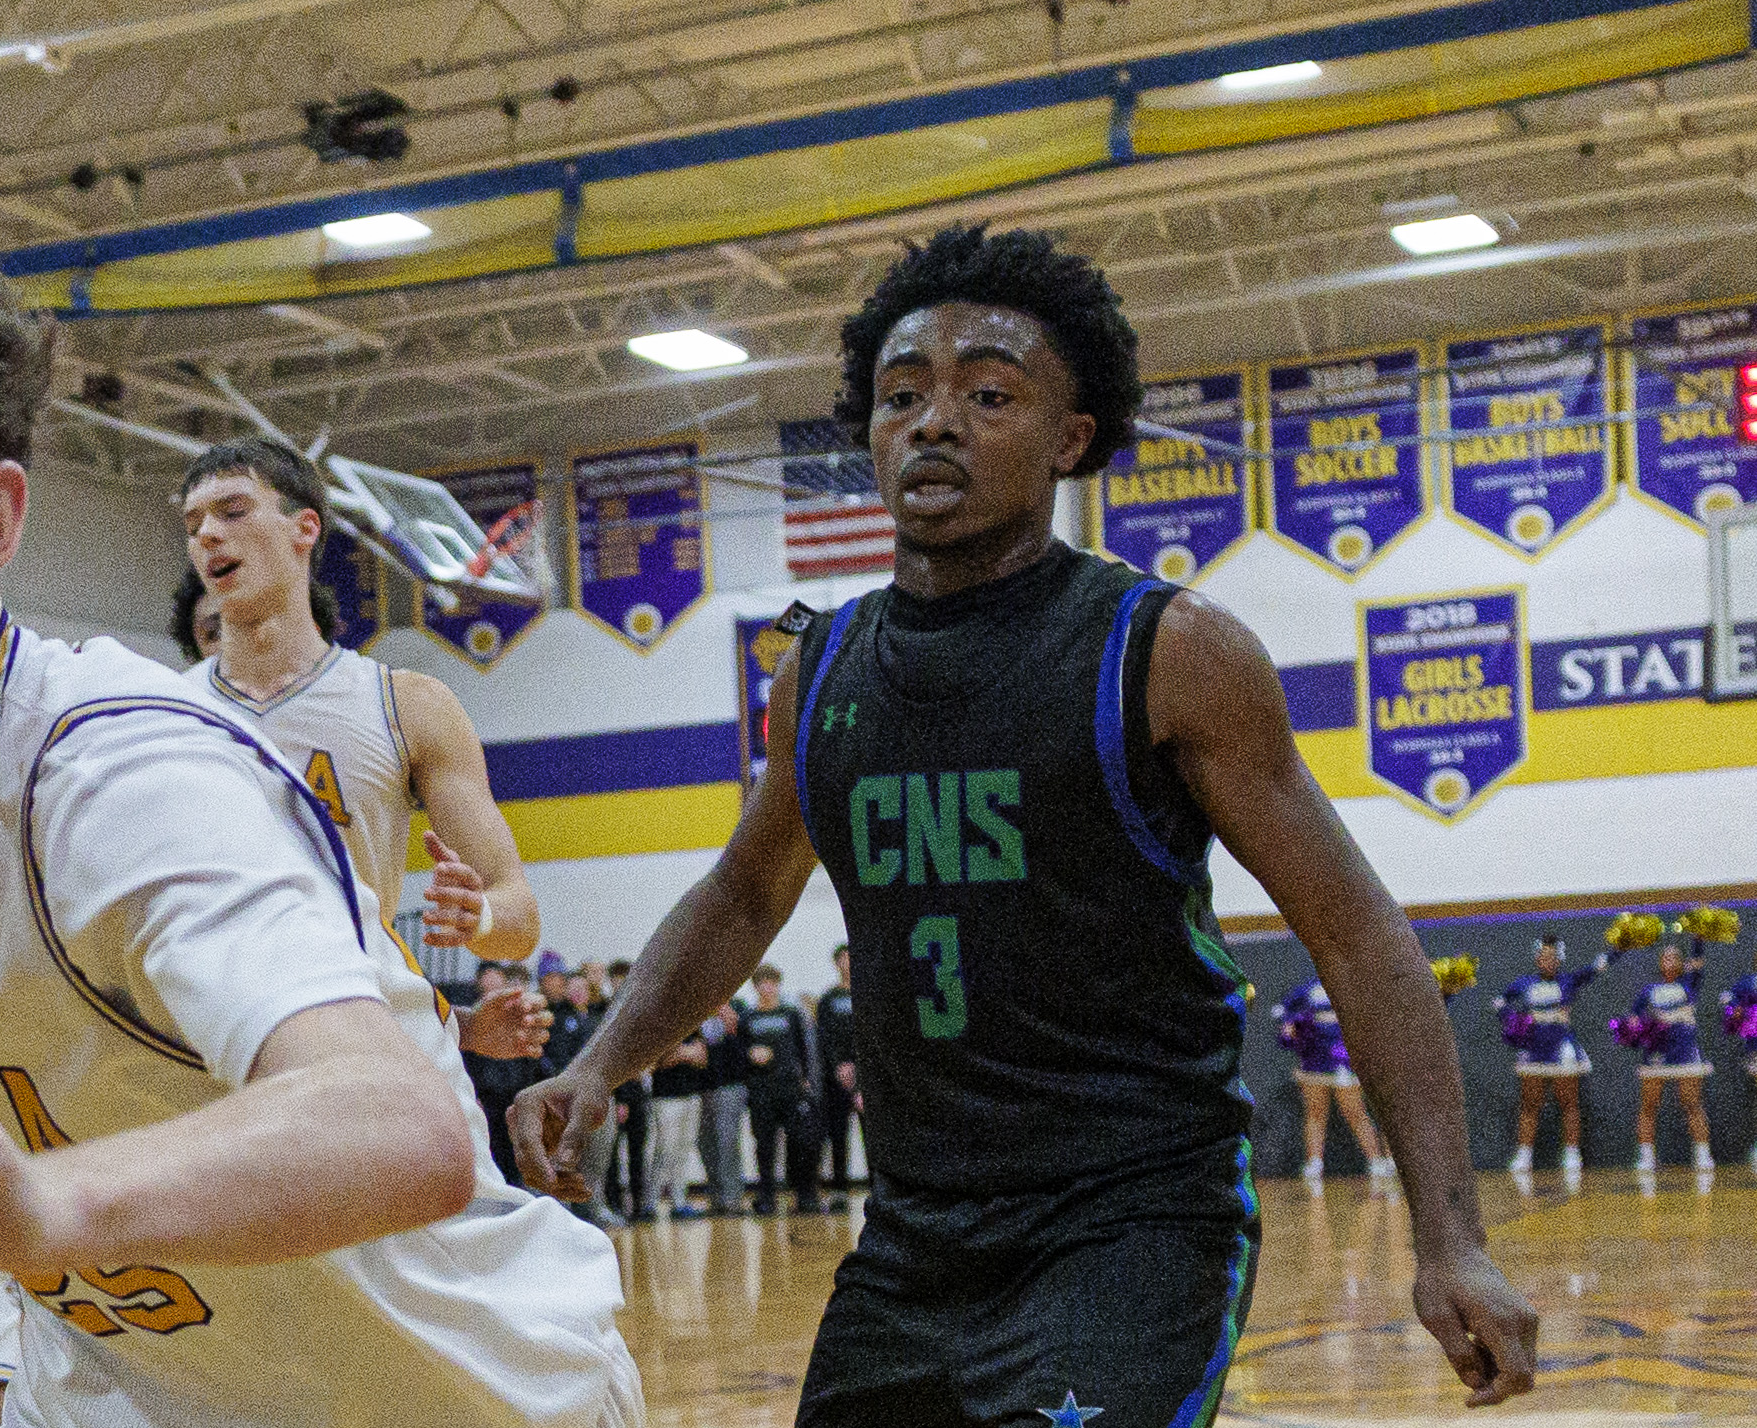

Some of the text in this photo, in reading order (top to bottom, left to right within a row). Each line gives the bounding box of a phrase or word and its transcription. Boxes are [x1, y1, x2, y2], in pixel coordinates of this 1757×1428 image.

[1309, 413, 1382, 448] BOYS
[1107, 462, 1239, 507] BASEBALL
[1294, 446, 1399, 487] SOCCER
[1402, 654, 1485, 693] GIRLS
[1375, 685, 1513, 731] LACROSSE
[850, 769, 1028, 887] CNS
[910, 915, 968, 1040] 3
